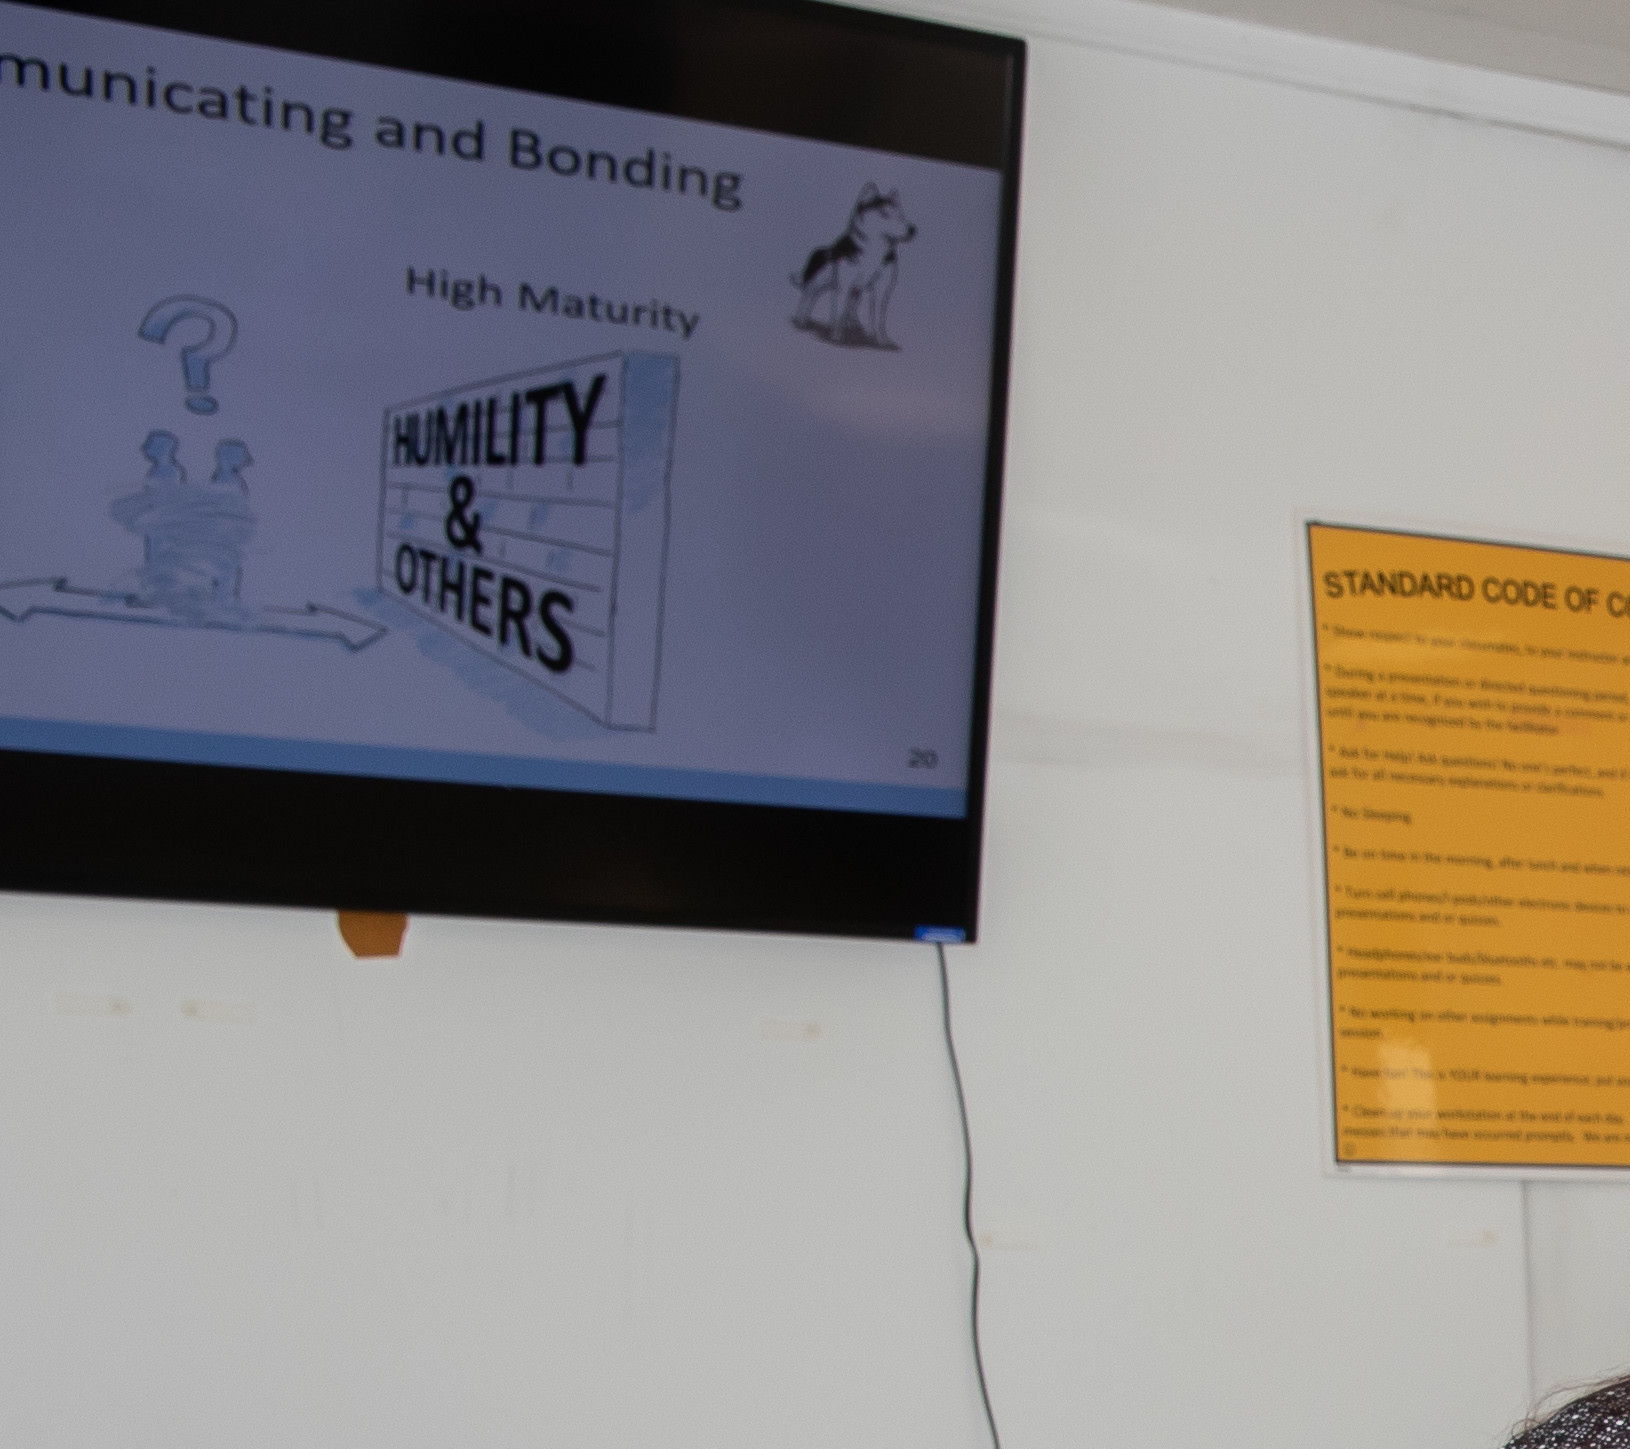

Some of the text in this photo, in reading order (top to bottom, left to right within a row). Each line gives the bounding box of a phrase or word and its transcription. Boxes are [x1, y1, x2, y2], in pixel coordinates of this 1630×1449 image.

[374, 115, 485, 163] and
[508, 126, 744, 212] Bonding
[405, 265, 700, 341] High Maturity
[393, 373, 607, 467] HUMILITY
[444, 474, 484, 556] &
[395, 543, 576, 675] OTHERS
[1323, 569, 1475, 602] STANDARD
[1481, 573, 1558, 610] CODE
[1563, 584, 1601, 613] OF
[907, 747, 938, 769] 20
